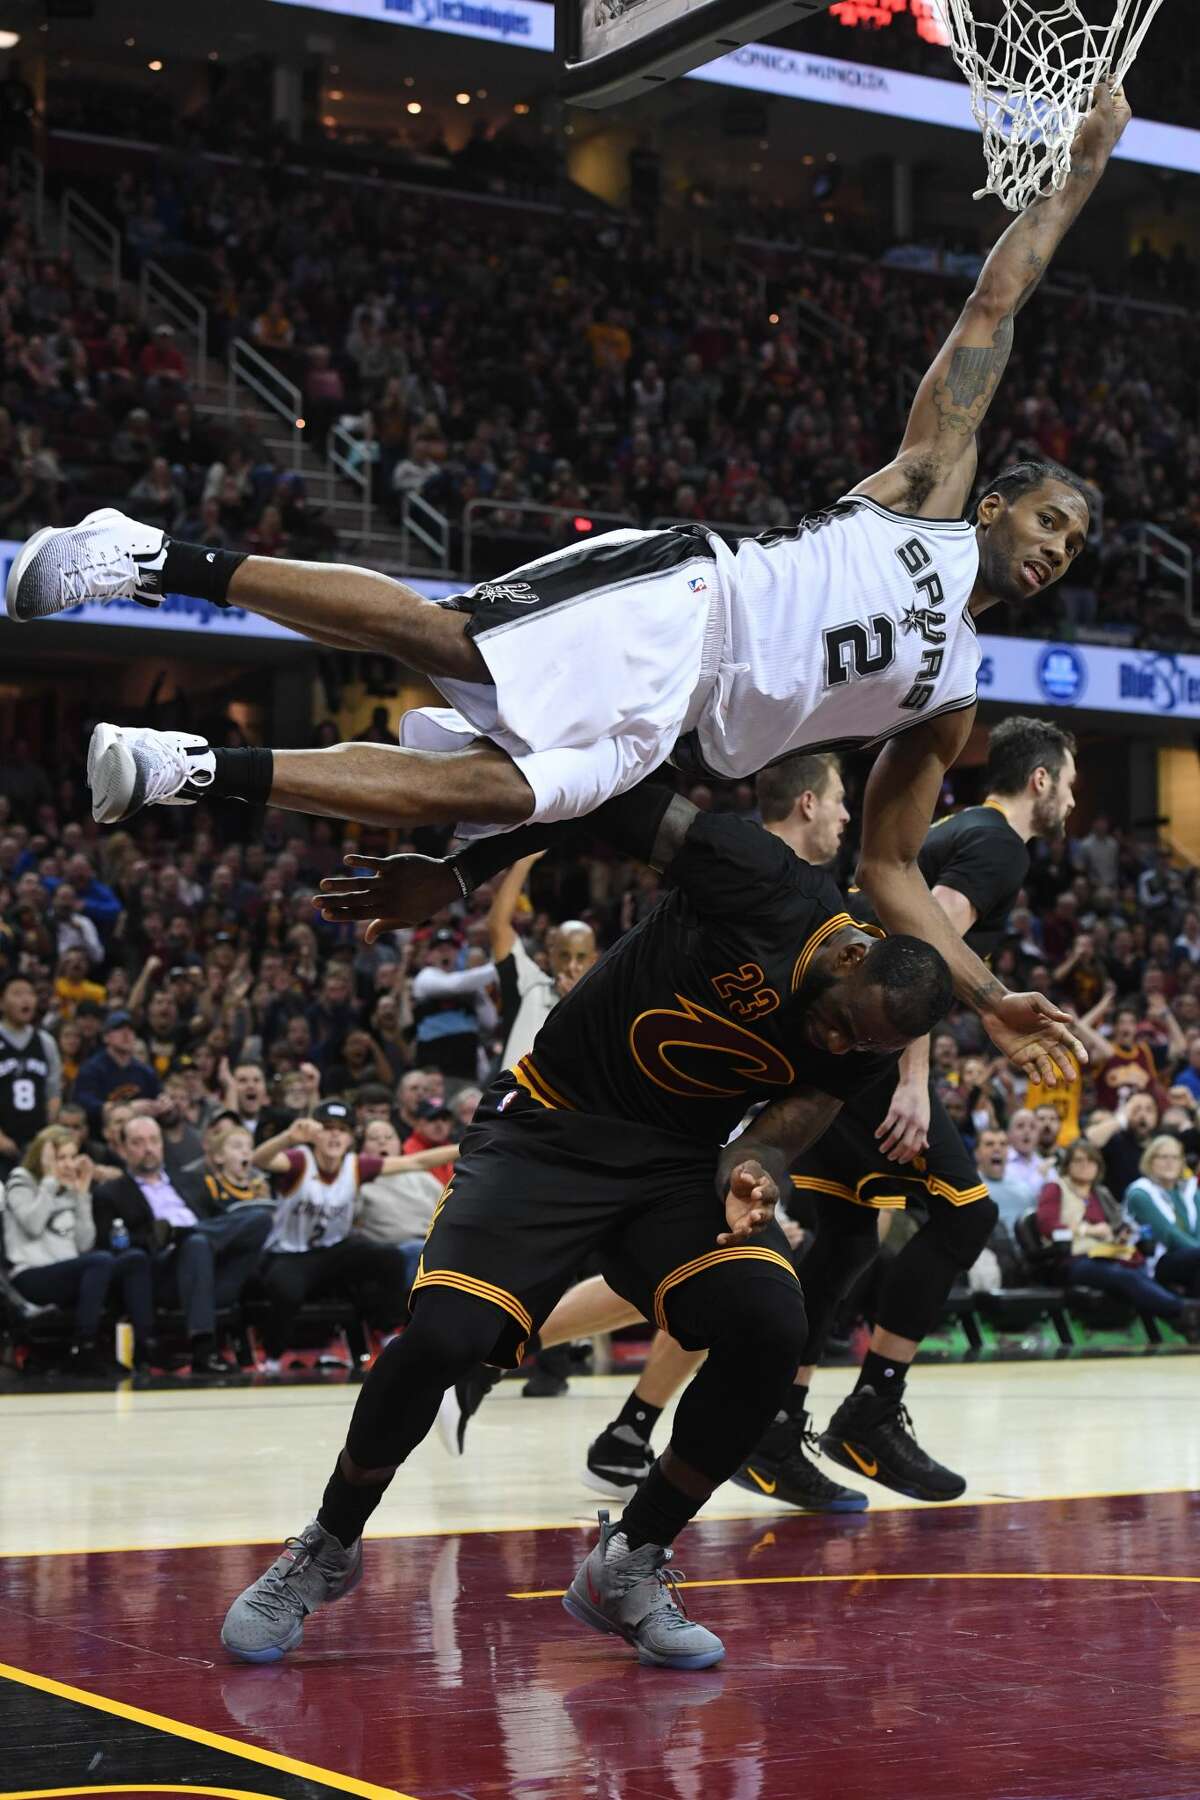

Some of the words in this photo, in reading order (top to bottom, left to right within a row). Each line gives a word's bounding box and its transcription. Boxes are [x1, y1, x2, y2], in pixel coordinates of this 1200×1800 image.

[822, 613, 896, 690] 2
[895, 535, 947, 709] SPURS
[711, 962, 780, 1022] 23
[12, 1079, 36, 1111] 8
